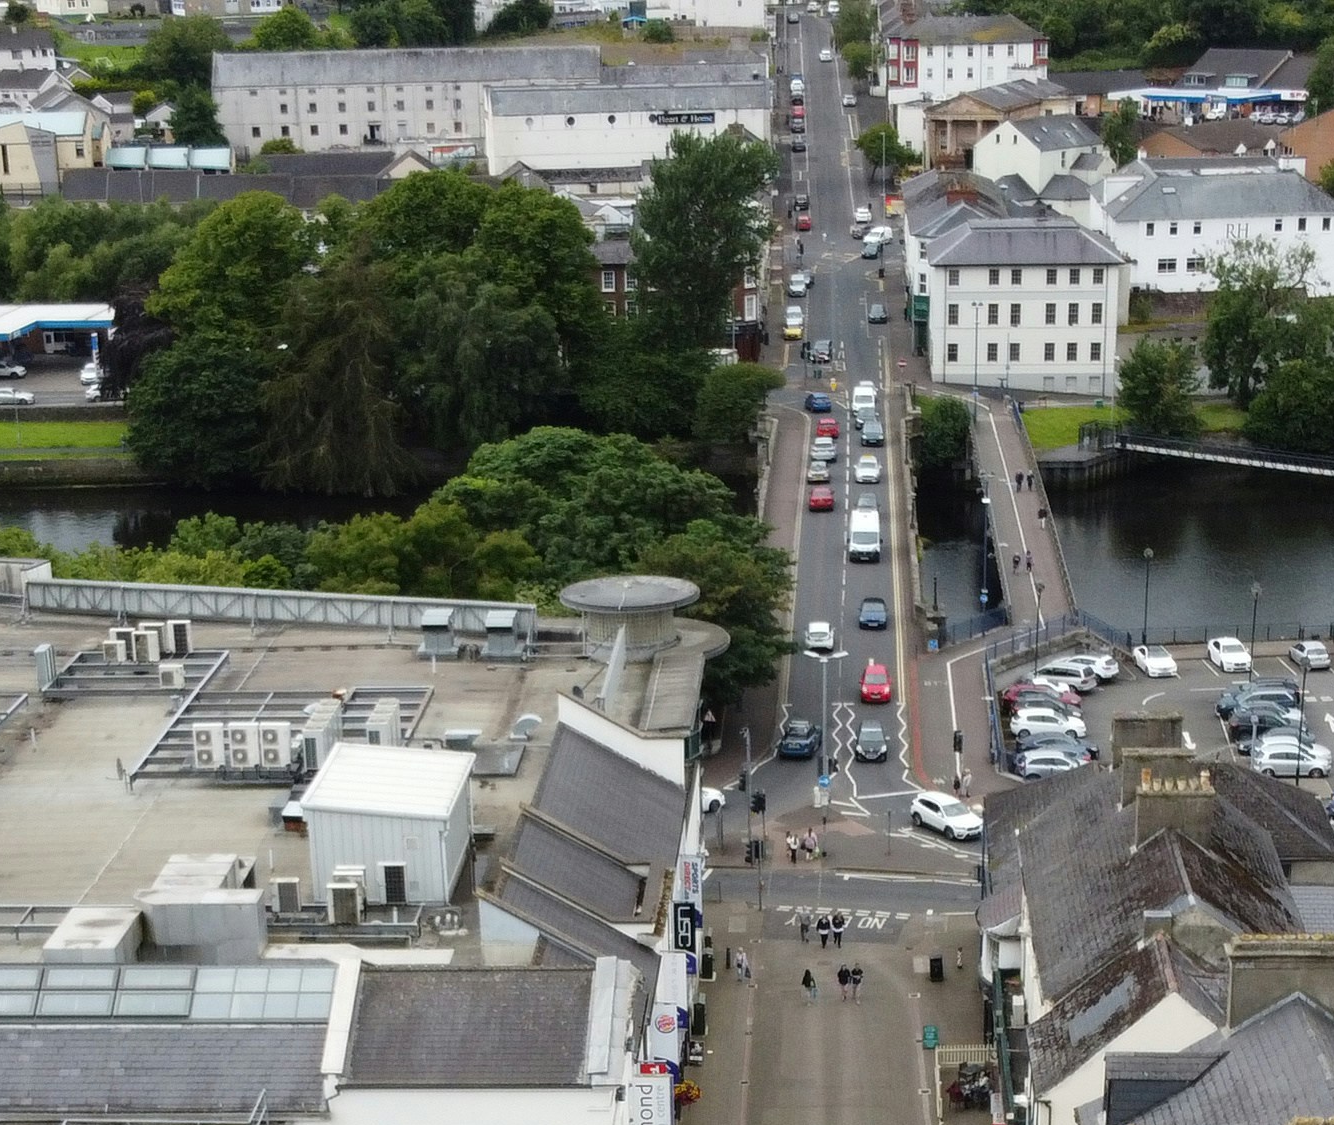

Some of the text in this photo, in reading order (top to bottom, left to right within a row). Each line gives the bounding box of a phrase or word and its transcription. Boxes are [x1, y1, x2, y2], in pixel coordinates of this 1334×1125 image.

[1227, 223, 1249, 239] RH
[677, 906, 692, 948] USC
[857, 916, 887, 930] NO
